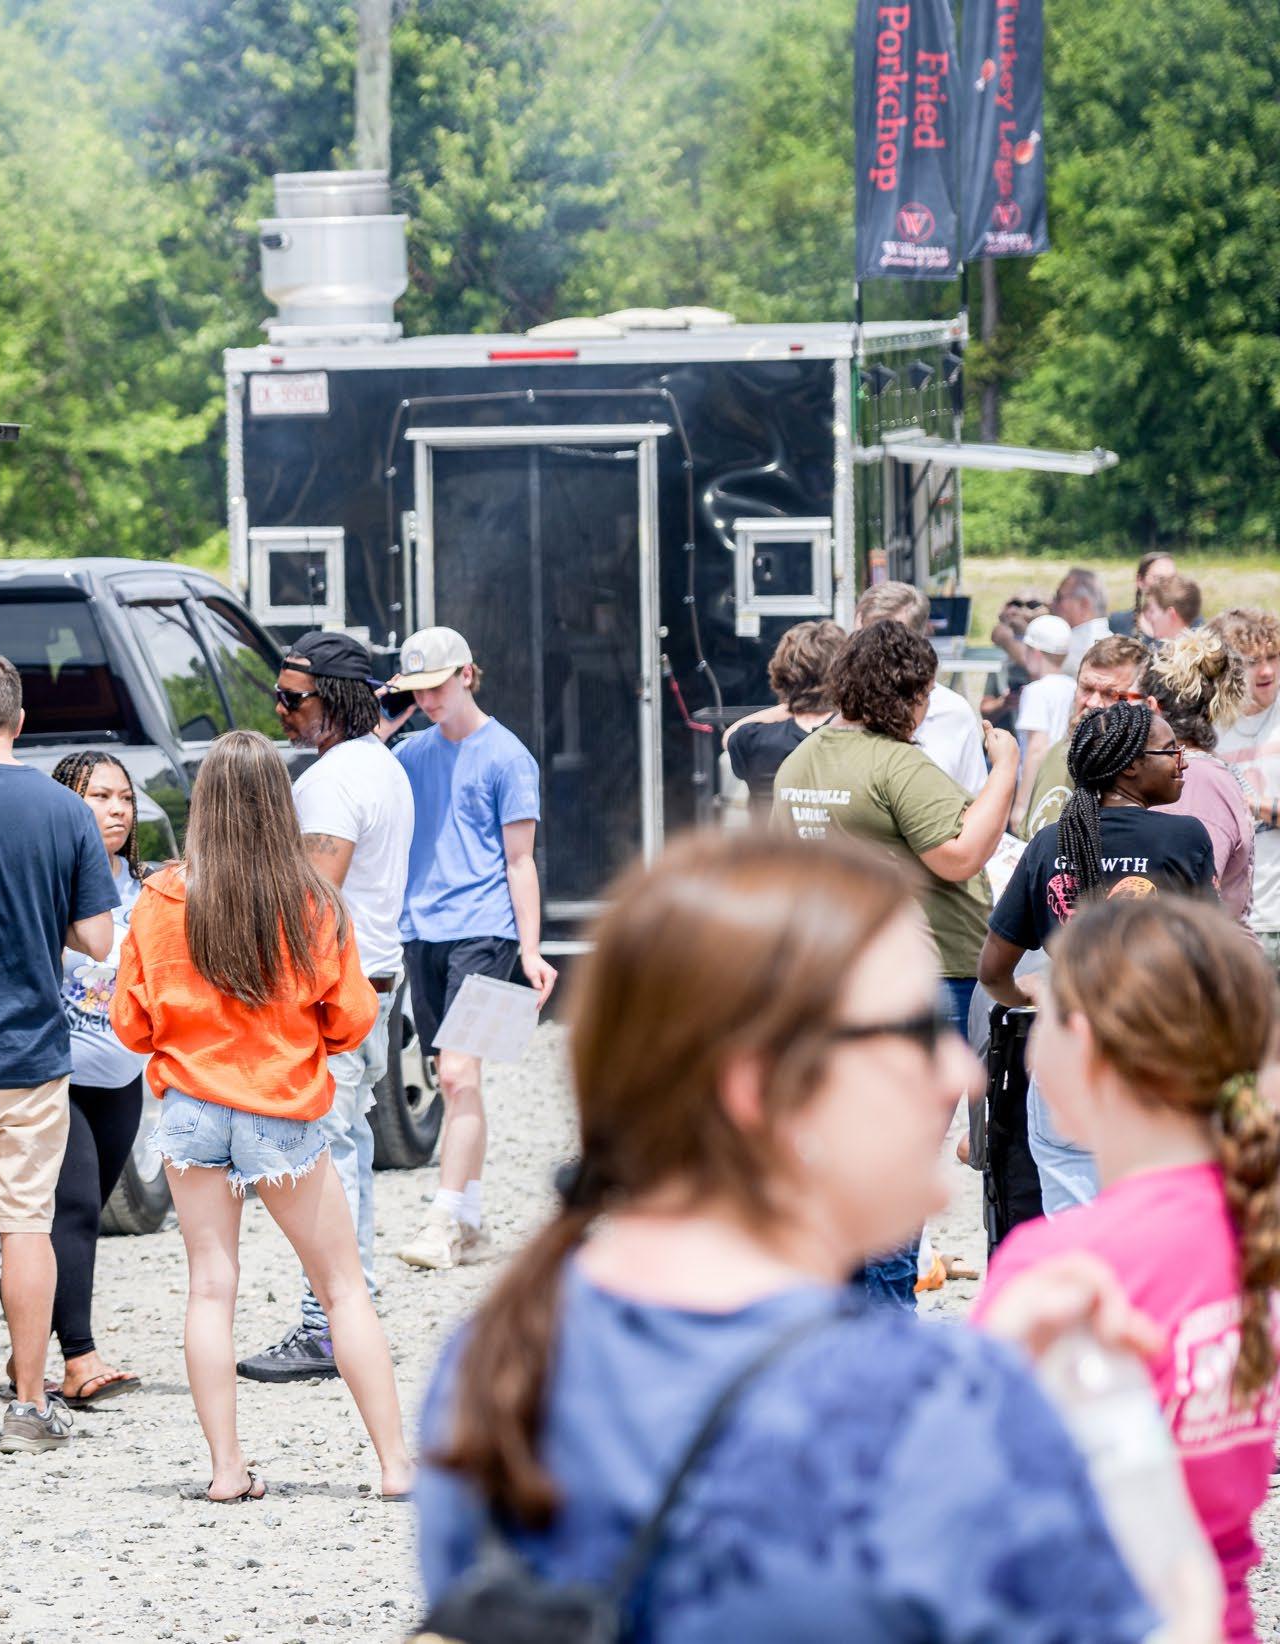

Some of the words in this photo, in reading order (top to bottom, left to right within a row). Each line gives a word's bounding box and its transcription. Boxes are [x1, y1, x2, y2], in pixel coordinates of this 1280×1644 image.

[869, 4, 910, 191] Porkchop
[913, 50, 949, 149] Fried
[1054, 855, 1149, 873] GWTH
